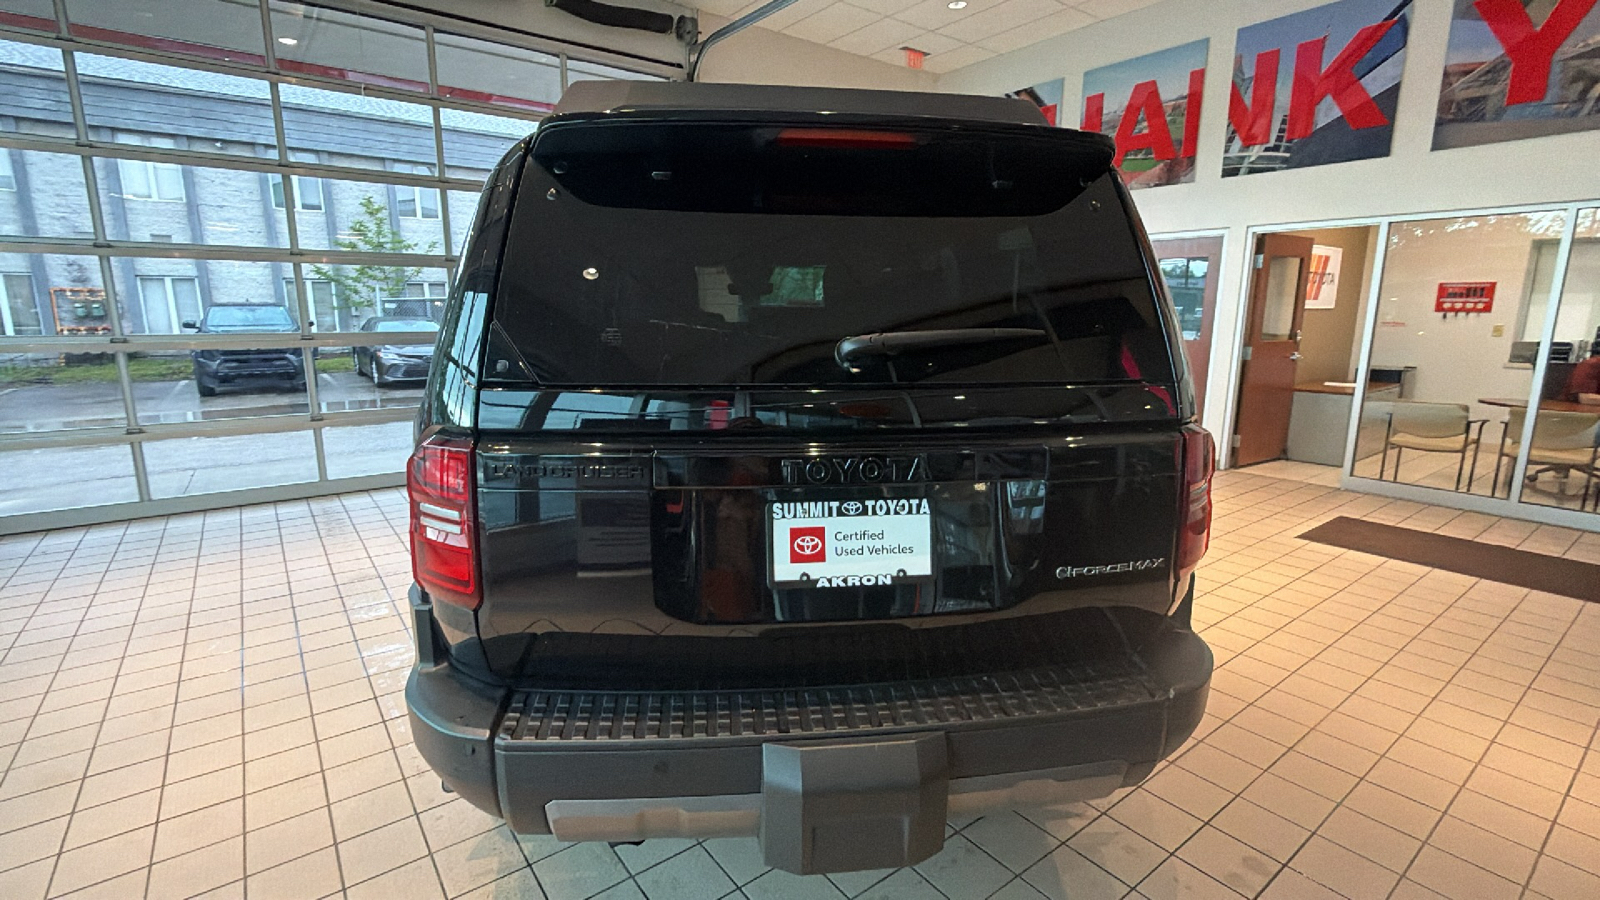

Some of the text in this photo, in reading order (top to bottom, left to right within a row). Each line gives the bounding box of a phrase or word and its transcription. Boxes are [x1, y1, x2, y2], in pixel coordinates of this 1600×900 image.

[781, 454, 932, 484] TOYOTA
[772, 498, 931, 519] SUMMIT TOYOTA
[834, 529, 885, 542] Certified
[834, 543, 914, 557] Used Vehicles
[816, 574, 892, 588] AKRON
